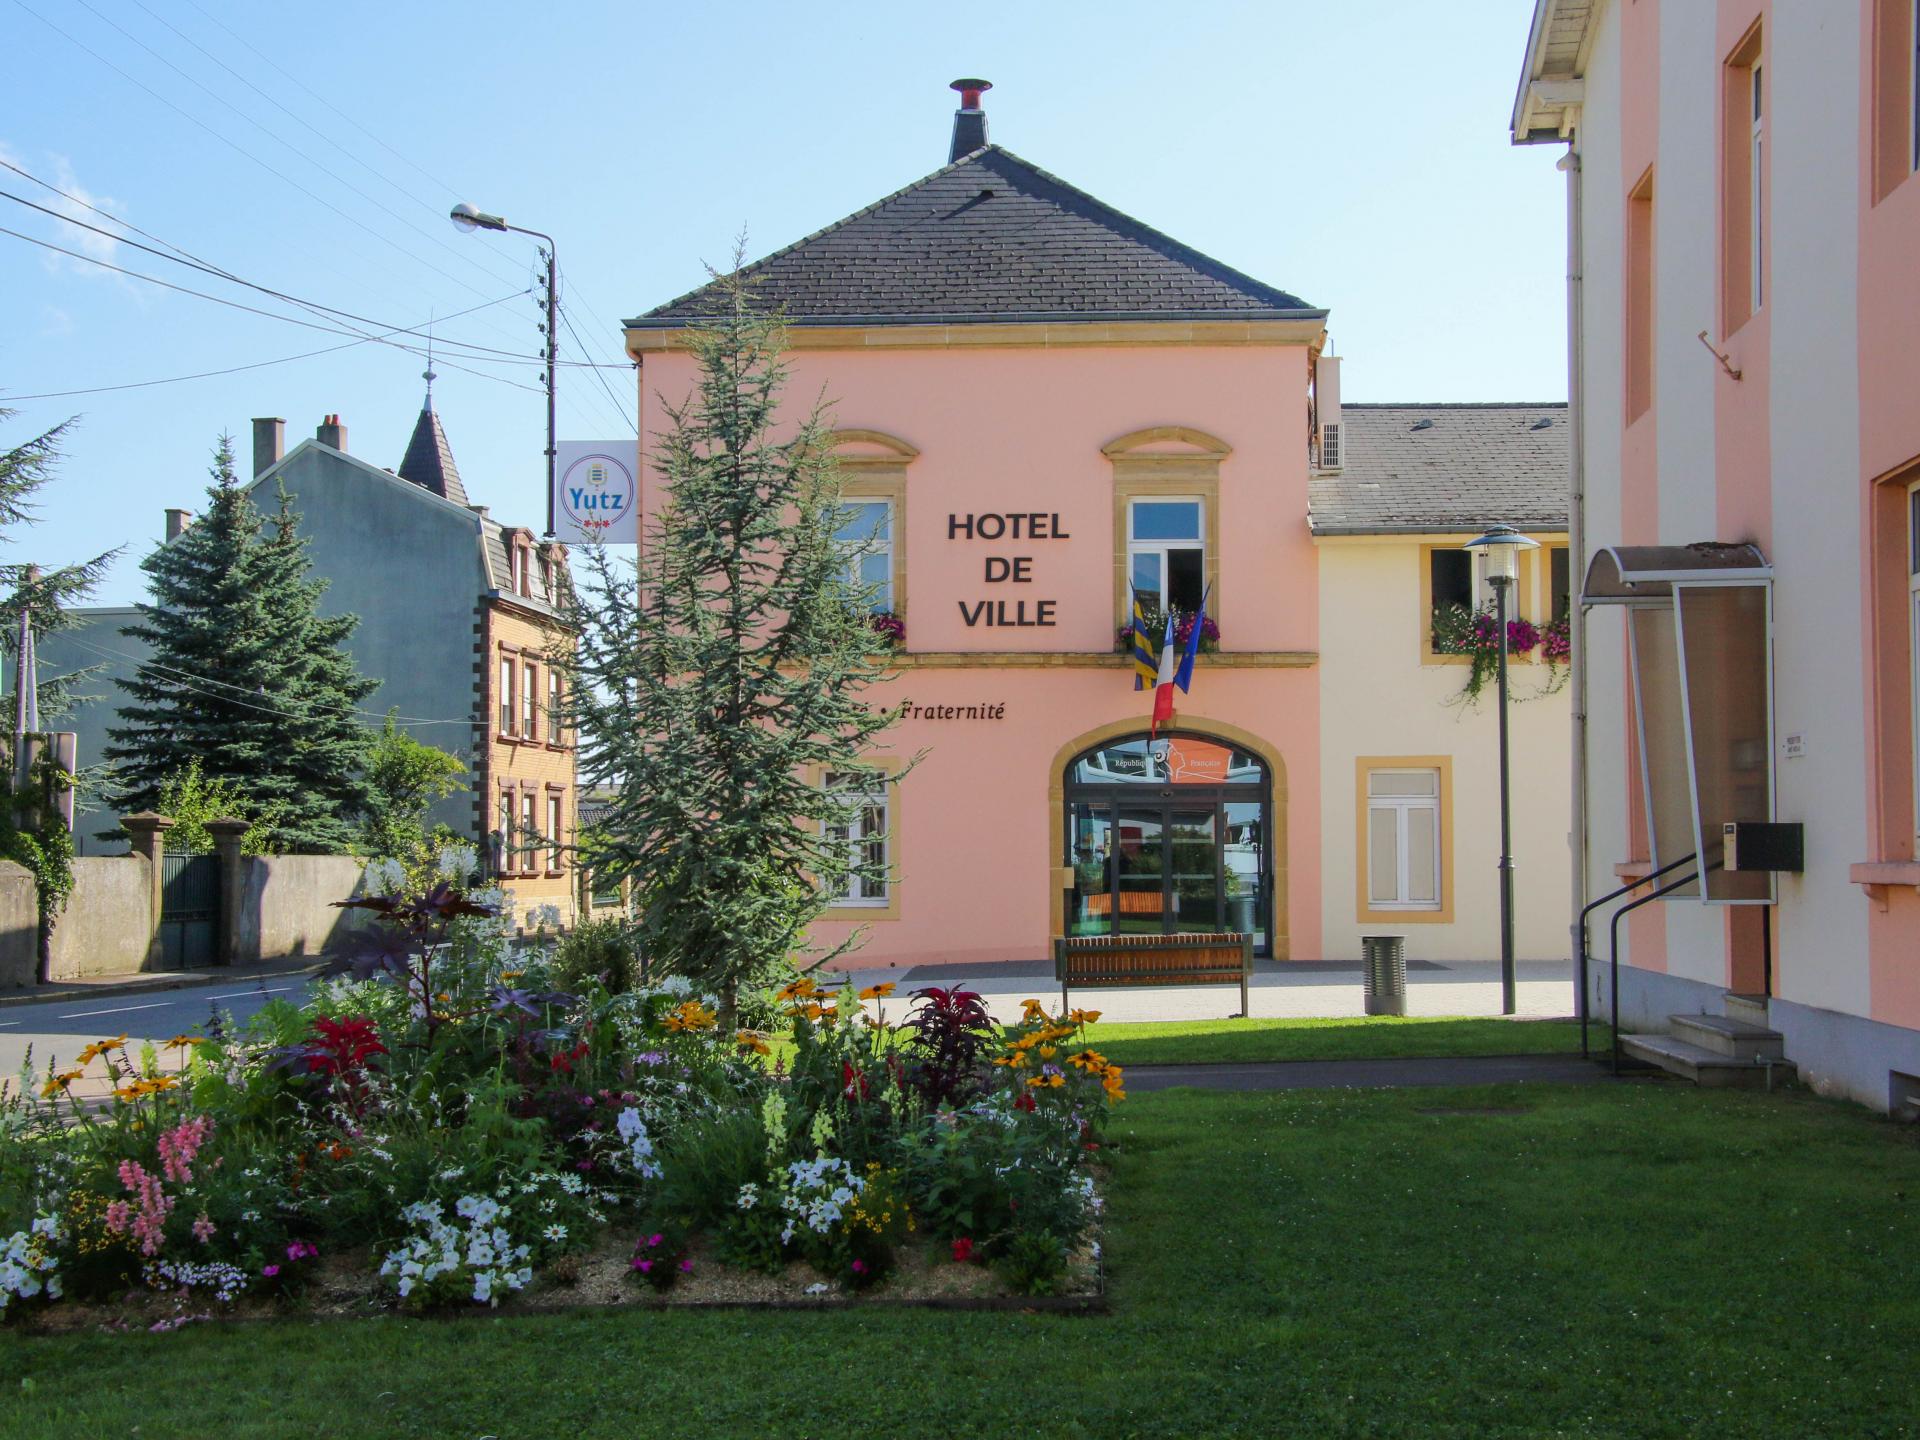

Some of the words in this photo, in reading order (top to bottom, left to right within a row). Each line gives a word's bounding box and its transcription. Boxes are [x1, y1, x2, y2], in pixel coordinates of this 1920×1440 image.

[569, 487, 623, 510] Yutz
[948, 513, 1070, 539] HOTEL
[984, 556, 1033, 583] DE
[958, 600, 1057, 627] VILLE
[900, 701, 1006, 720] Fraternité
[1115, 759, 1150, 768] Républiq
